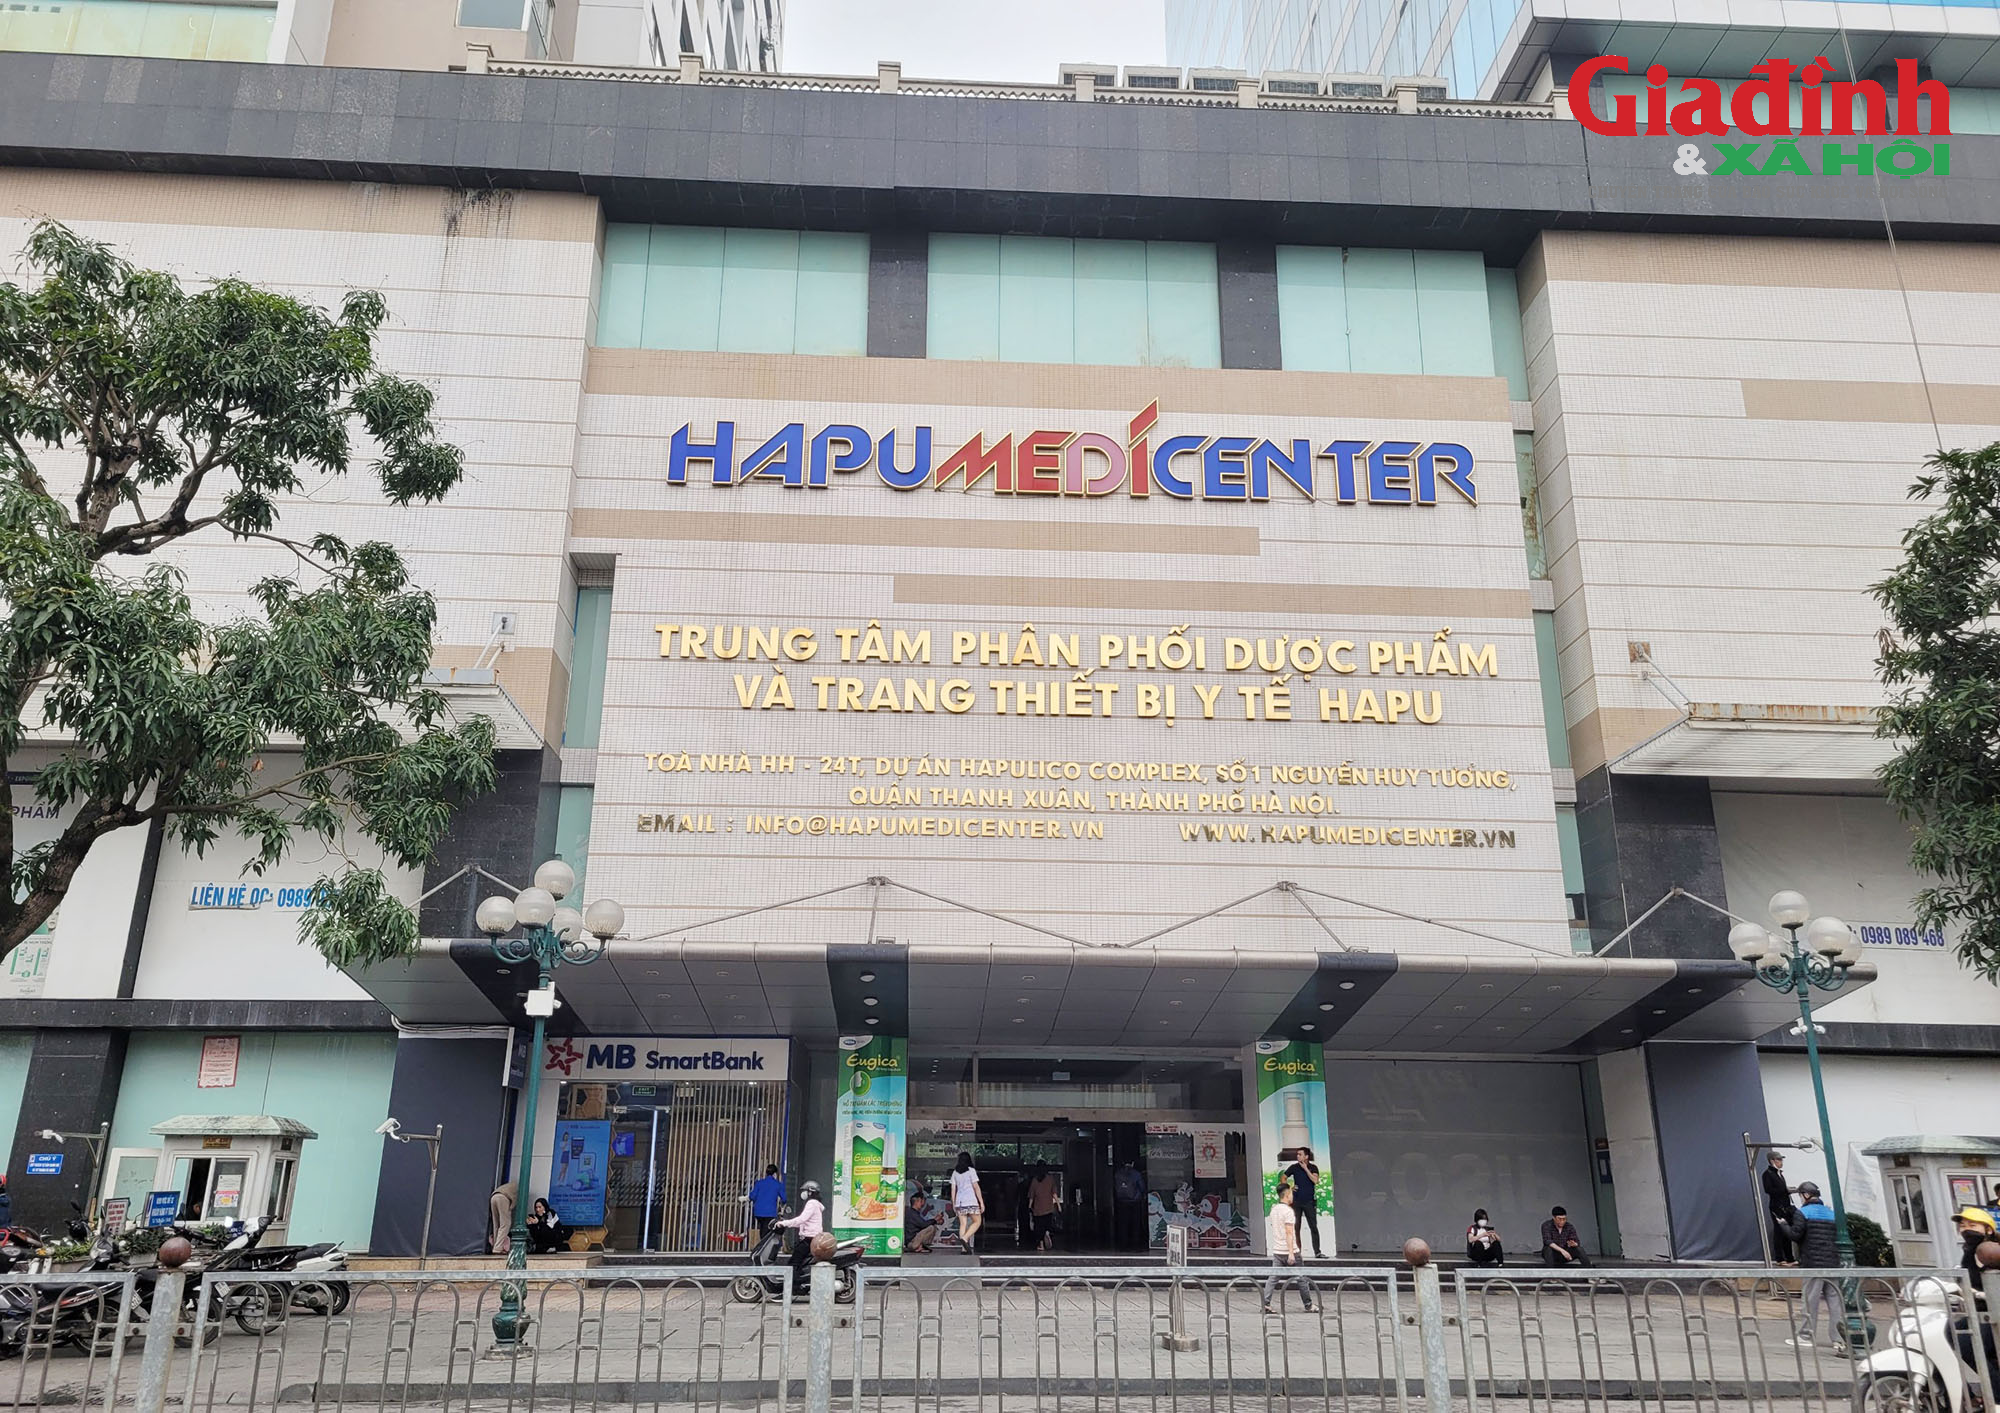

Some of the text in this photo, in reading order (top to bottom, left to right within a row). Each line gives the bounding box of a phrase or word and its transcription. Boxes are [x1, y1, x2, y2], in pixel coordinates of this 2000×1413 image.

[655, 619, 1498, 681] TRUNG TÂM PHÂN PHỐI DƯỢC PHẨM
[734, 664, 1442, 727] VÀ TRANG THIẾT BỊ Y TẾ HAPU
[645, 750, 693, 772] TOÀ
[700, 750, 752, 773] NHÀ
[760, 754, 795, 774] HH
[819, 756, 866, 777] 24T,
[876, 756, 912, 780] DỰ
[916, 753, 950, 776] ÁN
[960, 758, 1081, 780] HAPULICO
[1089, 762, 1208, 785] COMPLEX,
[1374, 767, 1420, 786] HUY
[849, 782, 921, 809] QUẬN
[930, 788, 1013, 808] THANH
[1023, 786, 1096, 812] XUÂN,
[1106, 787, 1190, 811] THÀNH
[1198, 787, 1246, 813] PHỐ
[1251, 790, 1284, 813] HÀ
[637, 813, 716, 834] EMAIL
[746, 815, 1104, 839] INFO@HAPUMEDICENTER.VN
[191, 882, 224, 907] LIÊN
[277, 888, 312, 908] 0989
[1860, 926, 1892, 944] 0989
[1895, 927, 1918, 945] 089
[1922, 928, 1945, 947] 468
[586, 1044, 764, 1070] MB SmartBank
[846, 1053, 898, 1071] Eugica
[1264, 1057, 1315, 1075] Eugica
[854, 1153, 881, 1164] Eugica
